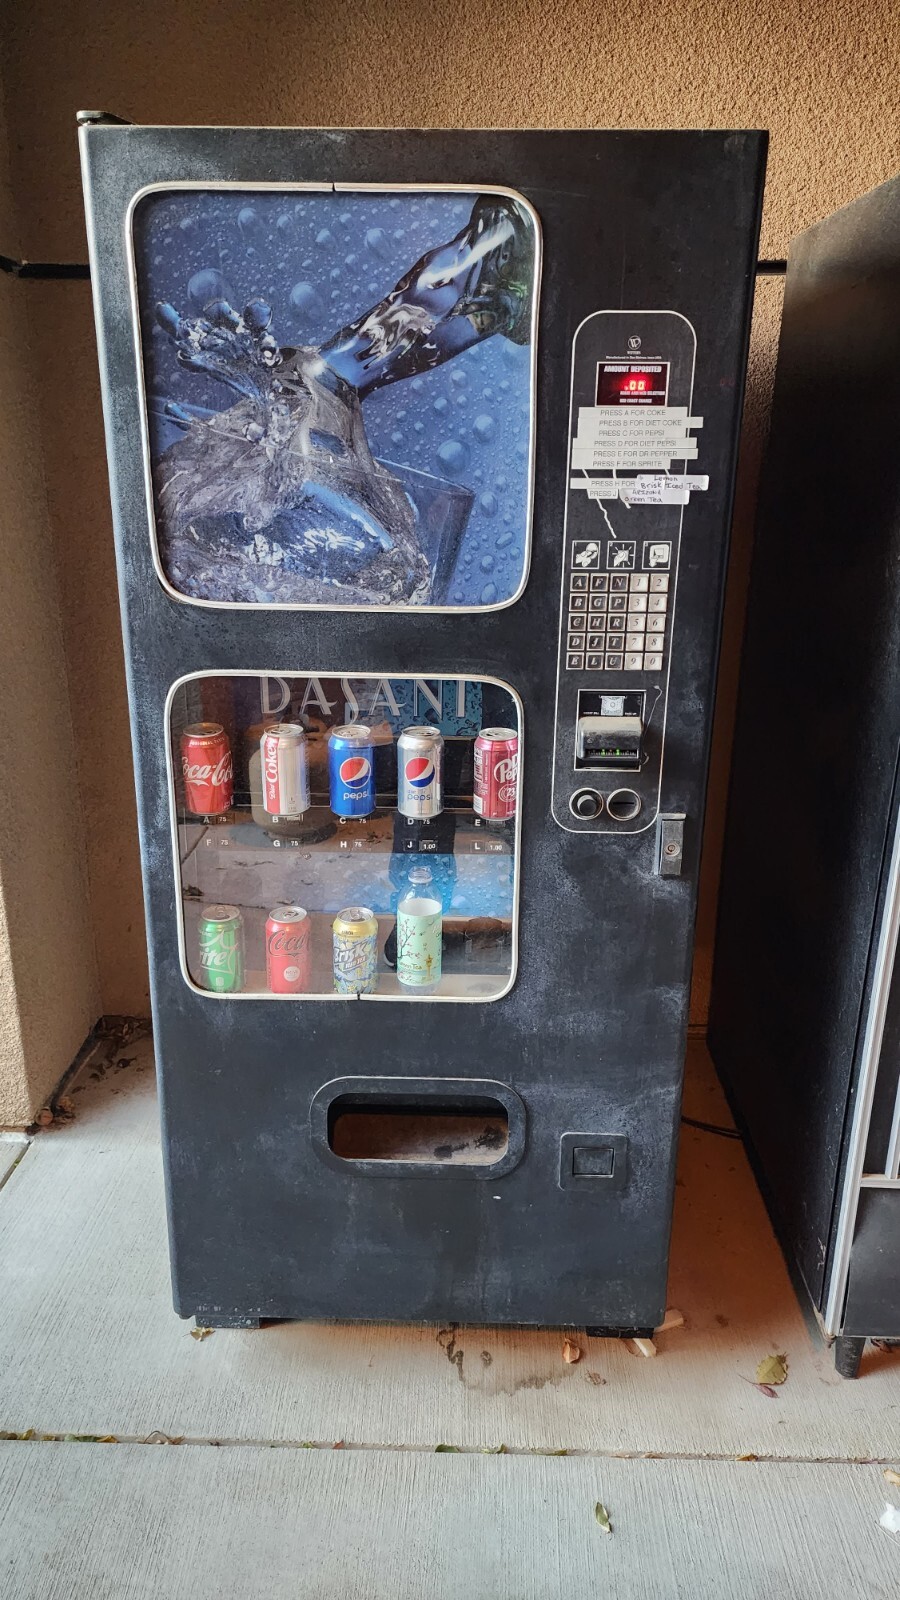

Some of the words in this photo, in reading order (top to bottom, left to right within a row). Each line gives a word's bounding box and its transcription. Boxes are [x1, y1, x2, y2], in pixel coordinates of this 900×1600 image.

[261, 677, 466, 724] DASANI
[266, 746, 277, 783] Coke
[344, 790, 368, 800] pepsi
[507, 788, 515, 796] 23
